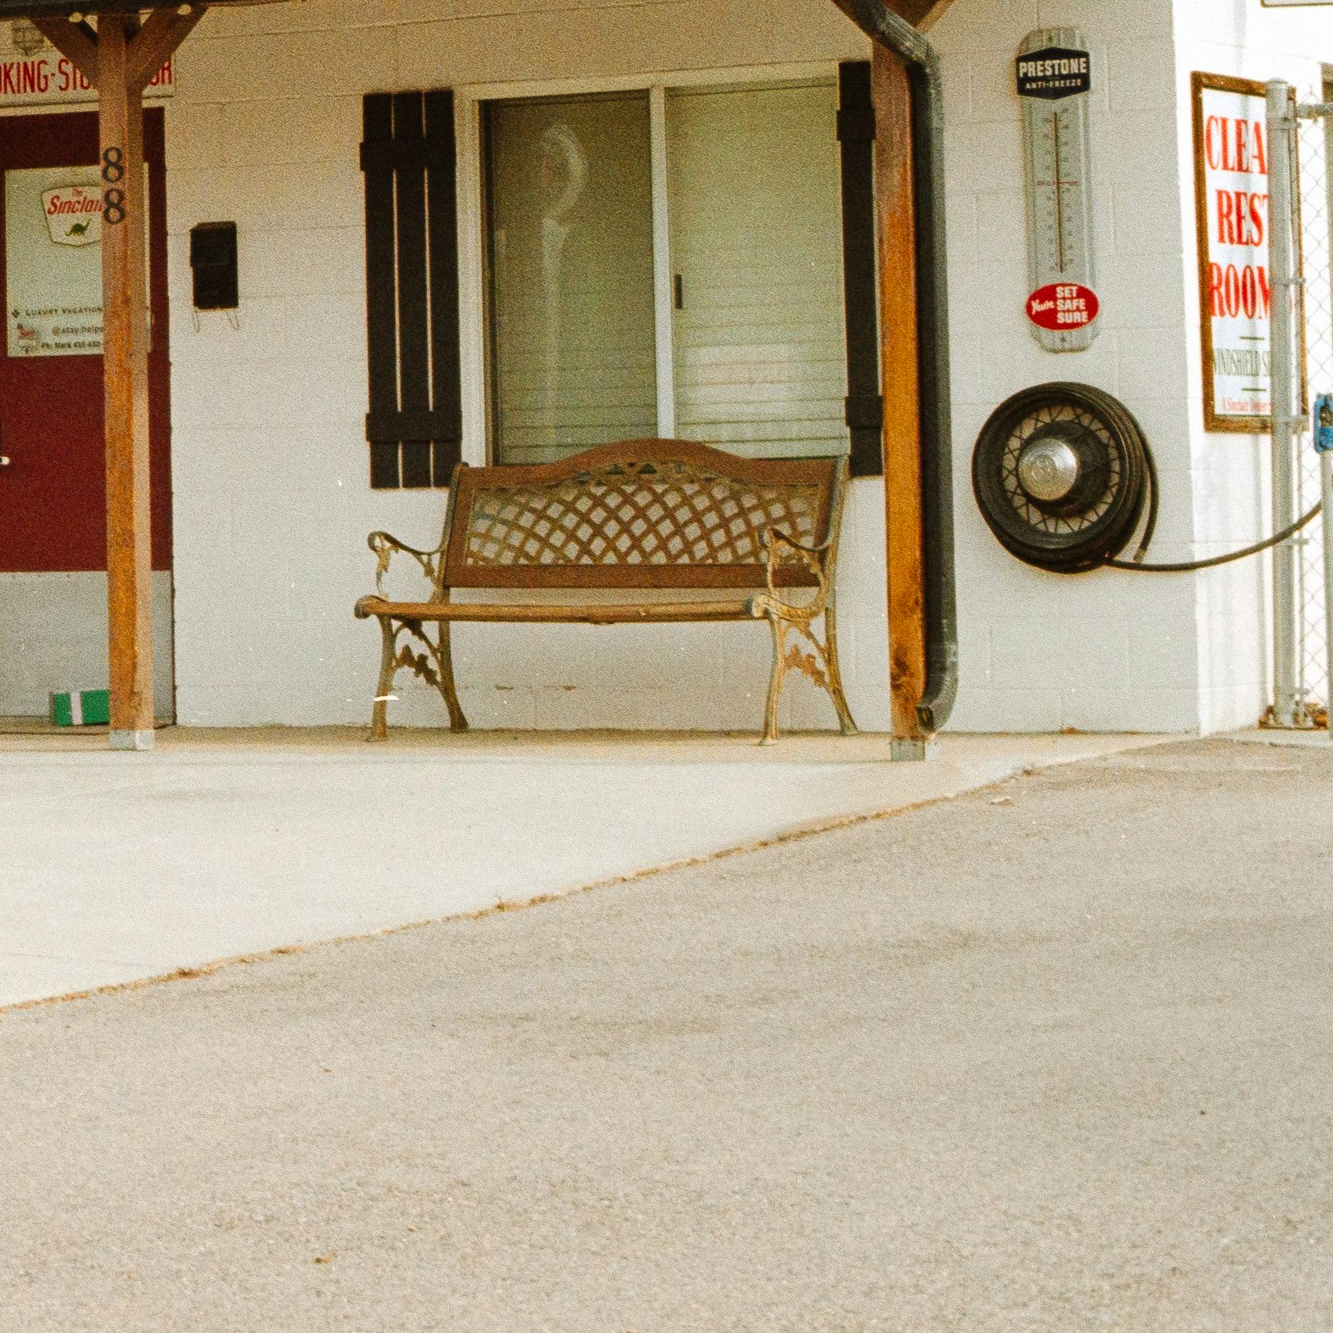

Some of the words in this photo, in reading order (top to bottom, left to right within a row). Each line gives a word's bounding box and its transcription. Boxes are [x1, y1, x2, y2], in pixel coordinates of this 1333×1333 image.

[1019, 58, 1087, 77] PRESTONE
[1025, 79, 1082, 89] ANTI-FREEZE
[1205, 114, 1269, 174] CLEA
[1056, 285, 1078, 298] SET
[1056, 298, 1086, 311] SAFE
[1056, 311, 1089, 324] SURE
